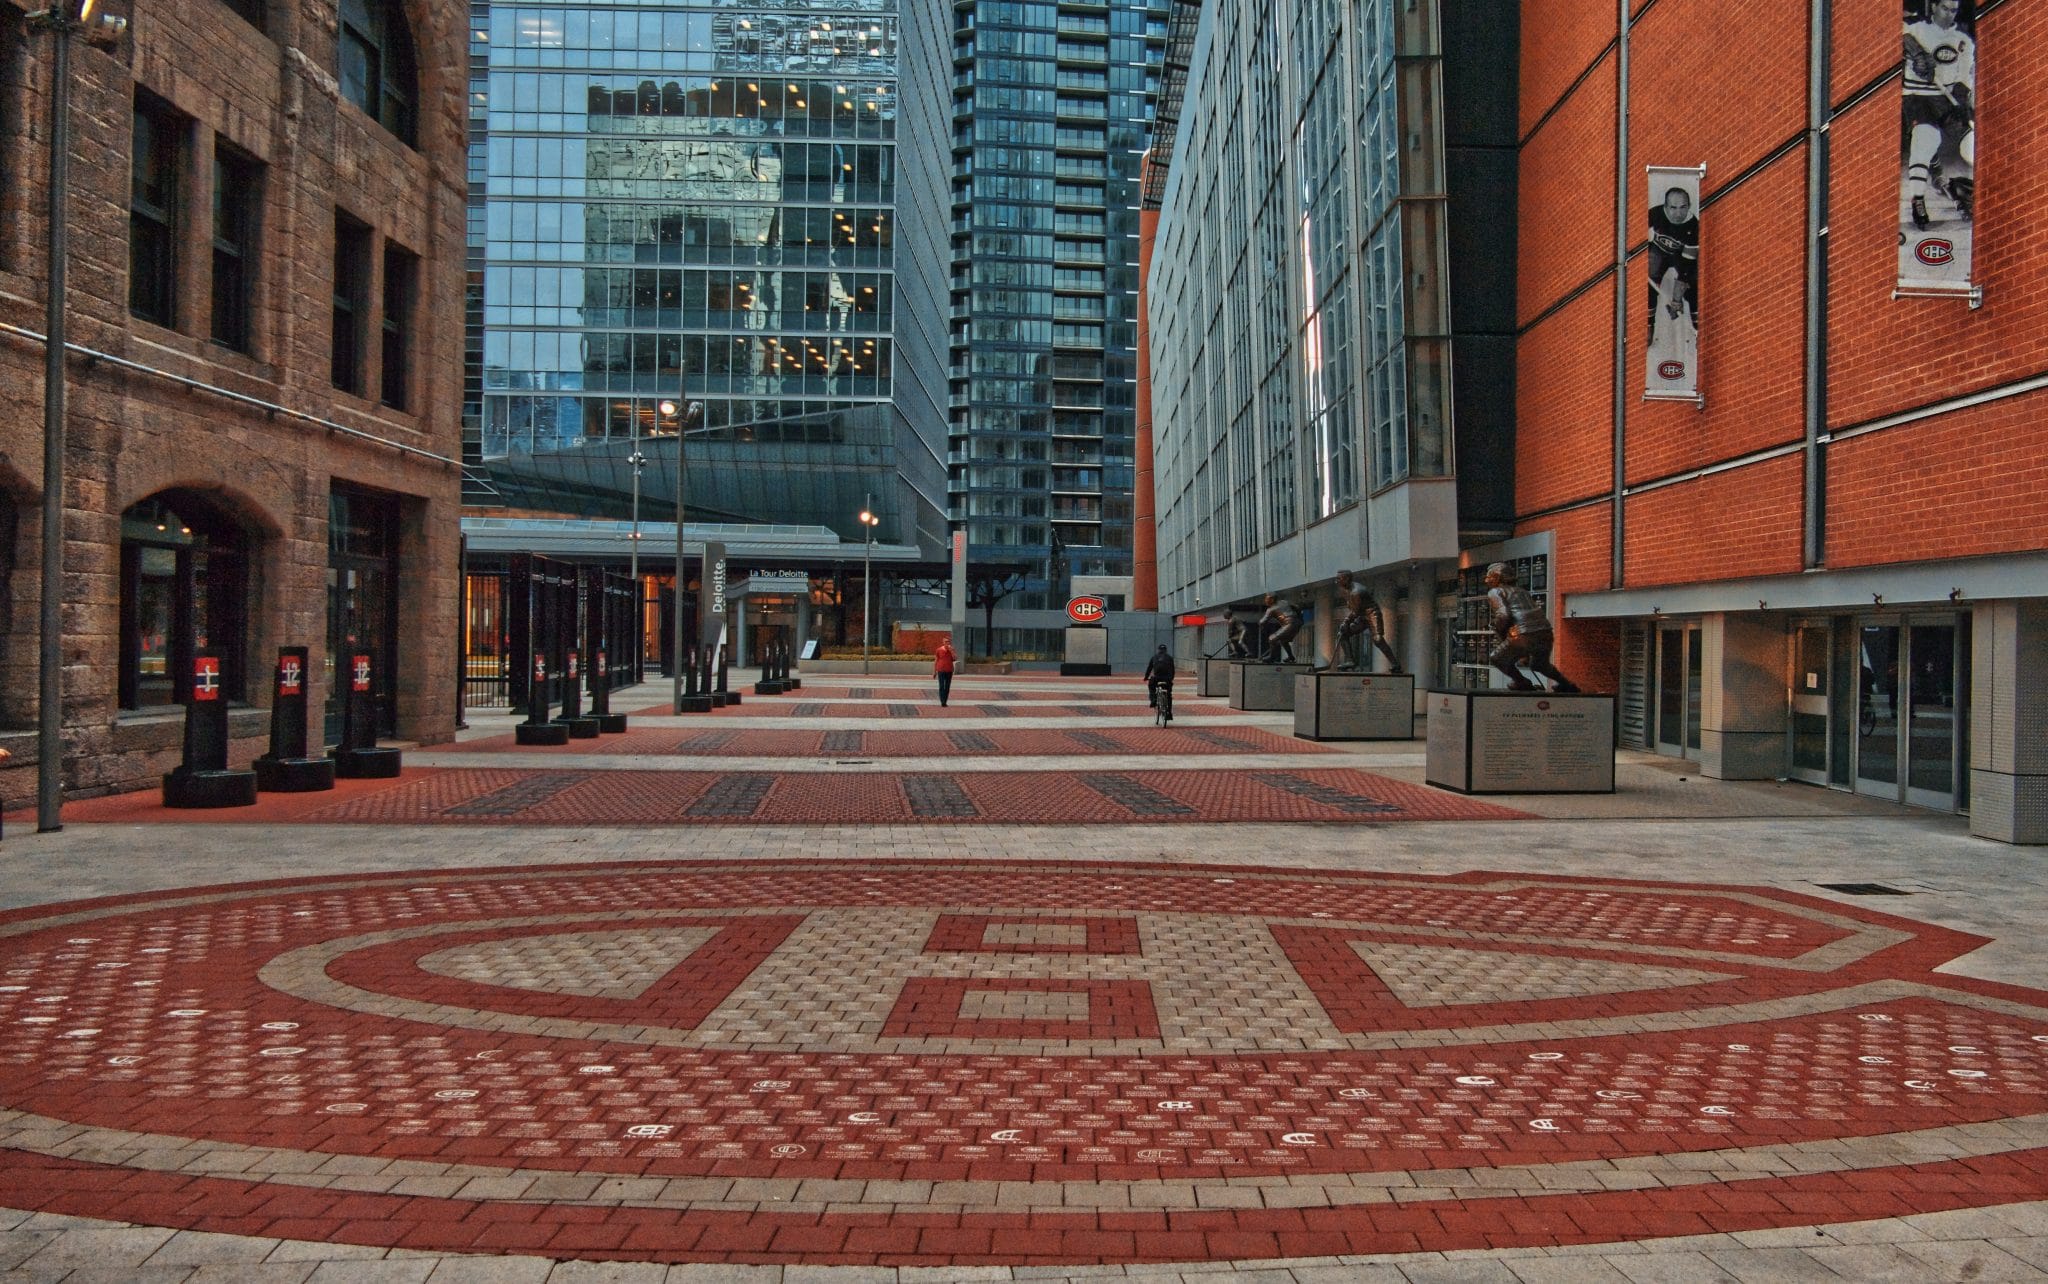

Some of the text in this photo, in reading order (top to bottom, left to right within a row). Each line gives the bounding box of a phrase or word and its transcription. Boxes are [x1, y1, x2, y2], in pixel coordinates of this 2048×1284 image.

[750, 569, 809, 578] La Tour Deloitte
